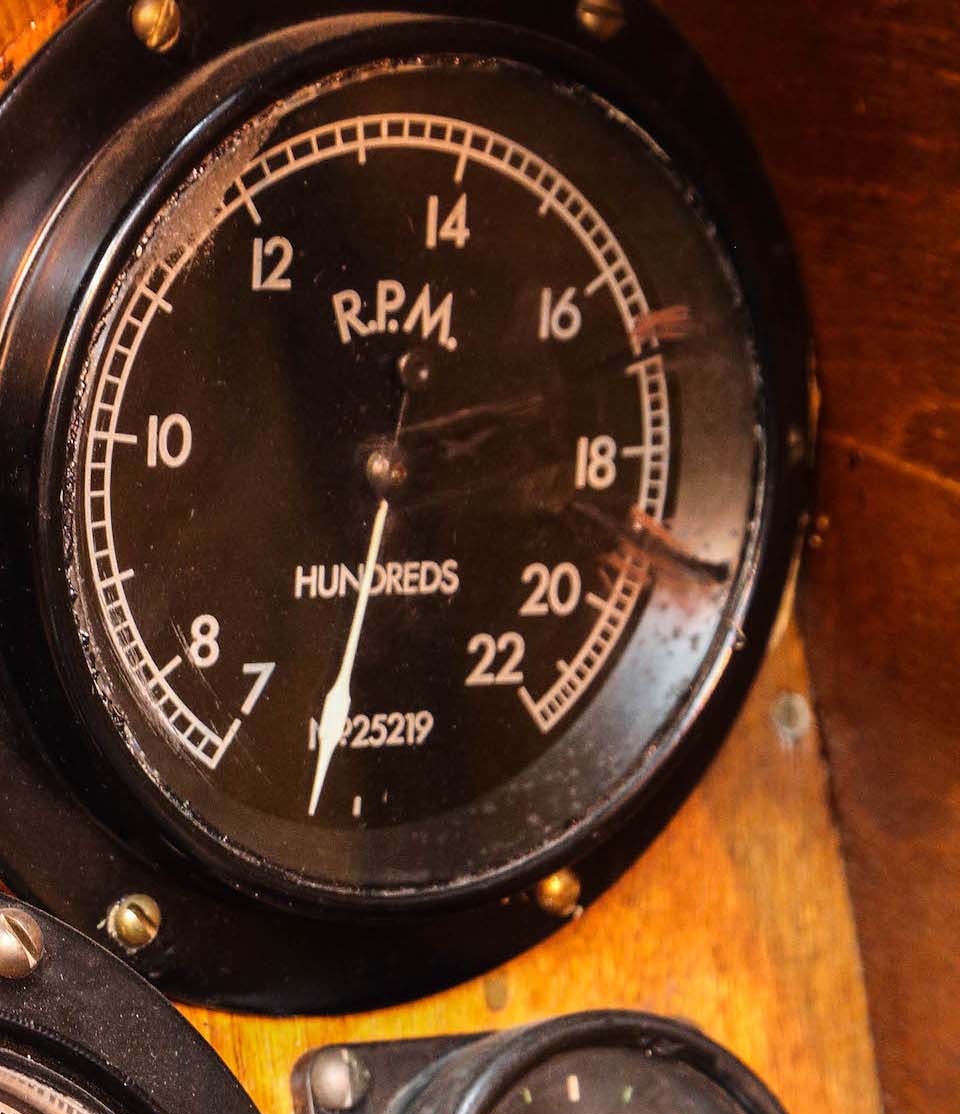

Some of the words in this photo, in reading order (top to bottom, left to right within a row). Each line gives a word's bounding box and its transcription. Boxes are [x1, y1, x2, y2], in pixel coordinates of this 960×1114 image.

[424, 194, 470, 250] 14
[251, 237, 294, 290] 12
[538, 288, 582, 339] 16
[146, 414, 192, 467] 10
[575, 437, 617, 489] 18
[293, 558, 460, 600] HUNDREDS
[520, 562, 582, 617] 20
[190, 613, 220, 667] 8
[465, 633, 526, 687] 22
[242, 663, 276, 714] 7
